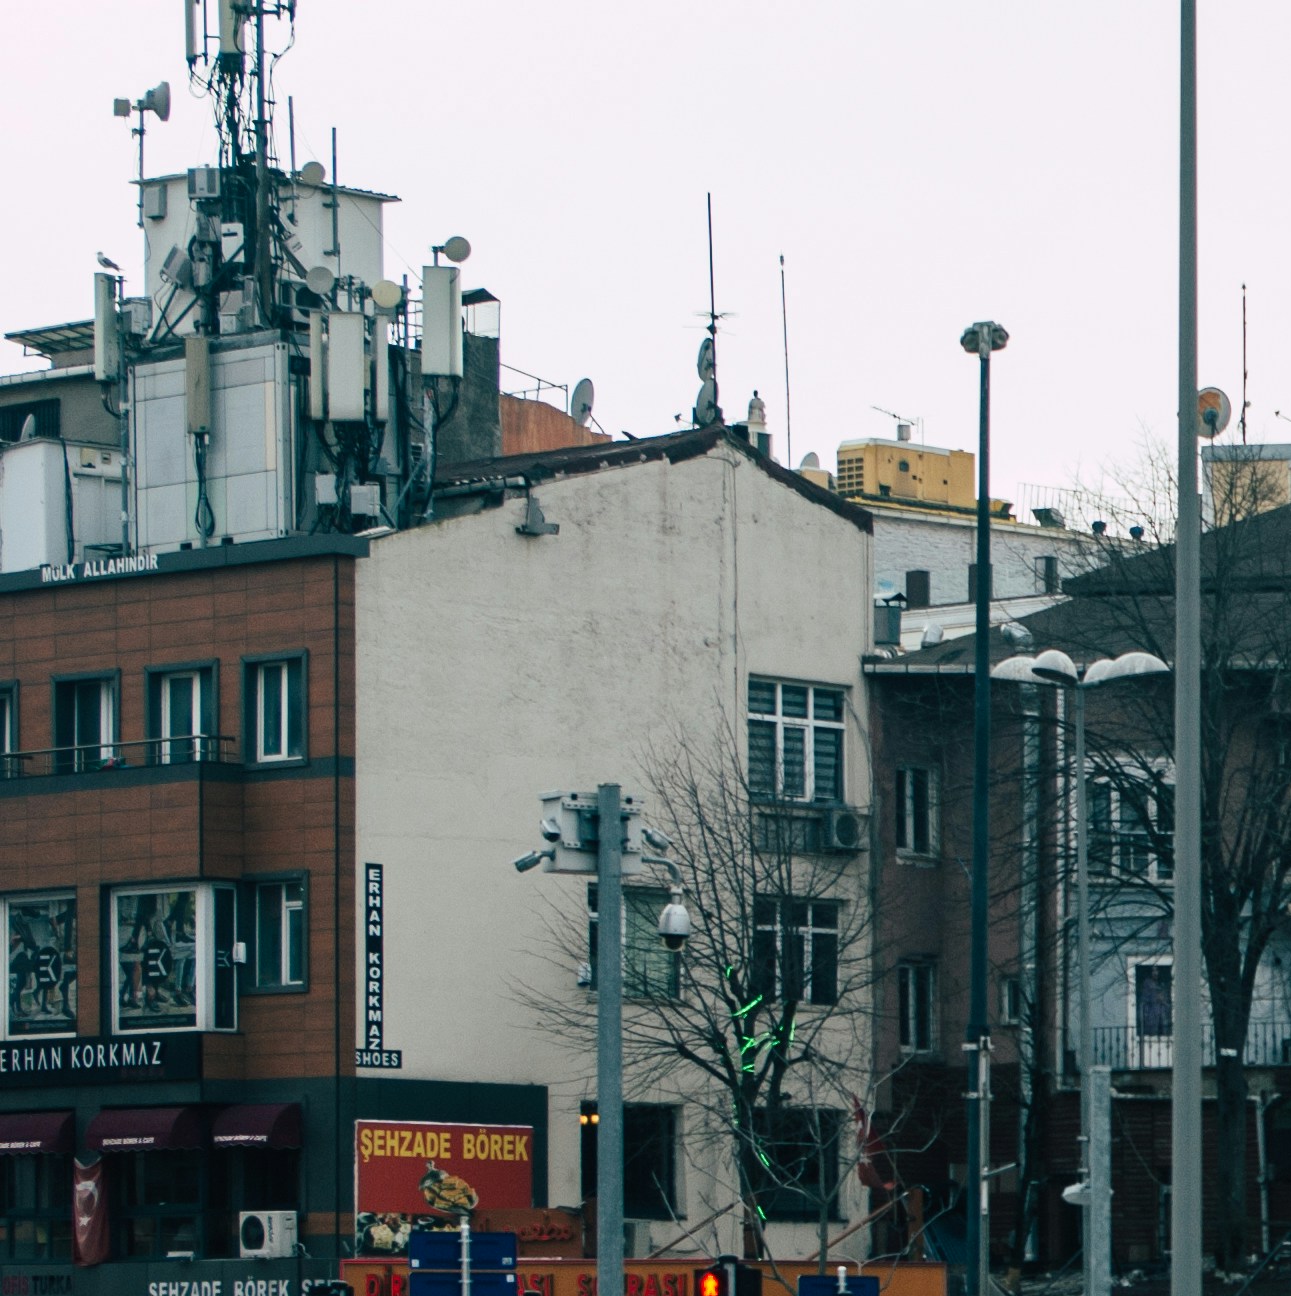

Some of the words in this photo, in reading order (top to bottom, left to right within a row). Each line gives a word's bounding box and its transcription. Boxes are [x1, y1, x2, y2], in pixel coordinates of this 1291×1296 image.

[42, 563, 76, 582] MÜLK
[368, 869, 381, 936] ERHAN
[368, 952, 382, 1050] KORKMAZ
[71, 1041, 162, 1069] KORKMAZ
[355, 1052, 399, 1067] SHOES
[360, 1128, 452, 1163] ŞEHZADE
[463, 1128, 529, 1161] BÖREK
